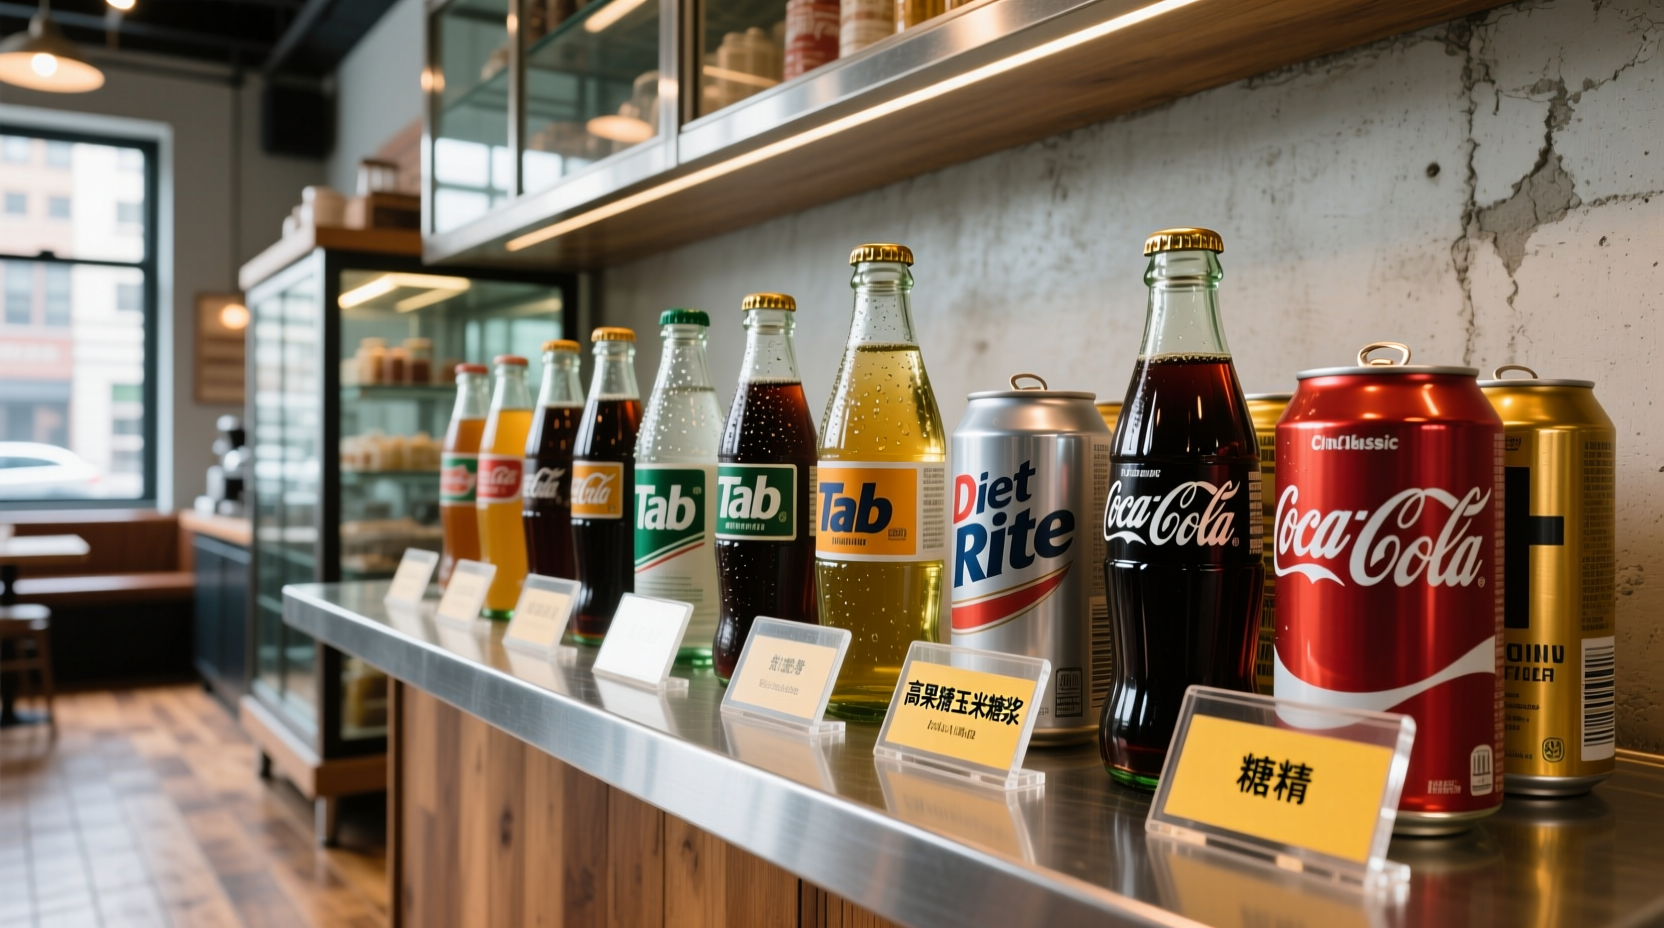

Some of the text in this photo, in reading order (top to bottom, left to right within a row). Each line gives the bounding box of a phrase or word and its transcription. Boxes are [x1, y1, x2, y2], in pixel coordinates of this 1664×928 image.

[635, 484, 696, 530] Tab
[718, 475, 781, 520] Tab
[818, 482, 893, 534] Tab
[953, 460, 1036, 525] Diet
[1103, 480, 1240, 547] Coca-Cola
[954, 508, 1075, 588] Rite
[1273, 484, 1491, 587] Coca-Cola
[1236, 752, 1313, 805] 糖精
